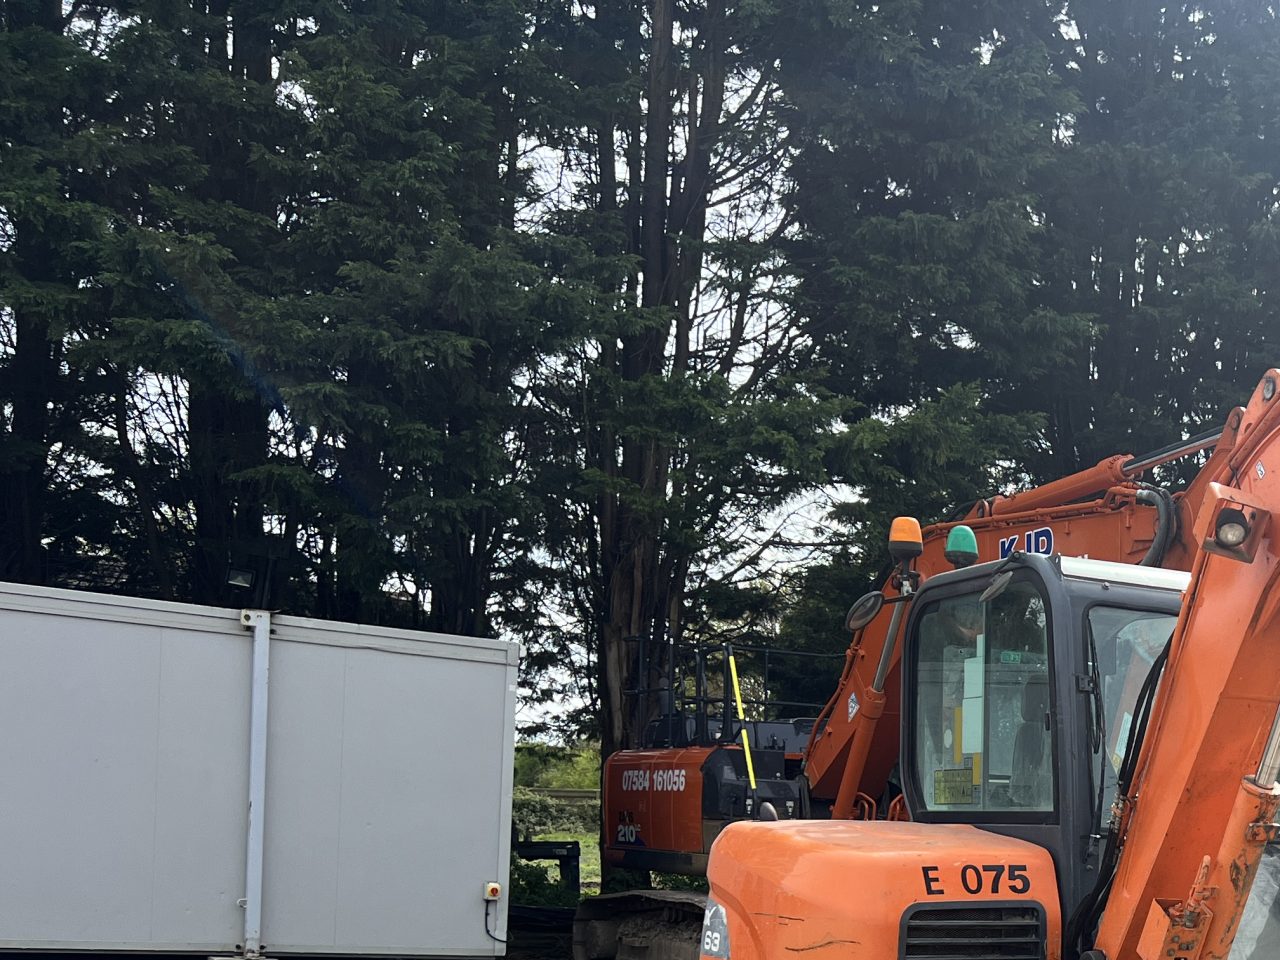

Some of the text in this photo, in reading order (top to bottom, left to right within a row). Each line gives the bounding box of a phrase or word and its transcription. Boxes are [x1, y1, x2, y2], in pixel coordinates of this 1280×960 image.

[622, 769, 686, 792] 07584 161056
[921, 864, 1030, 895] E 075
[704, 930, 720, 952] 63
